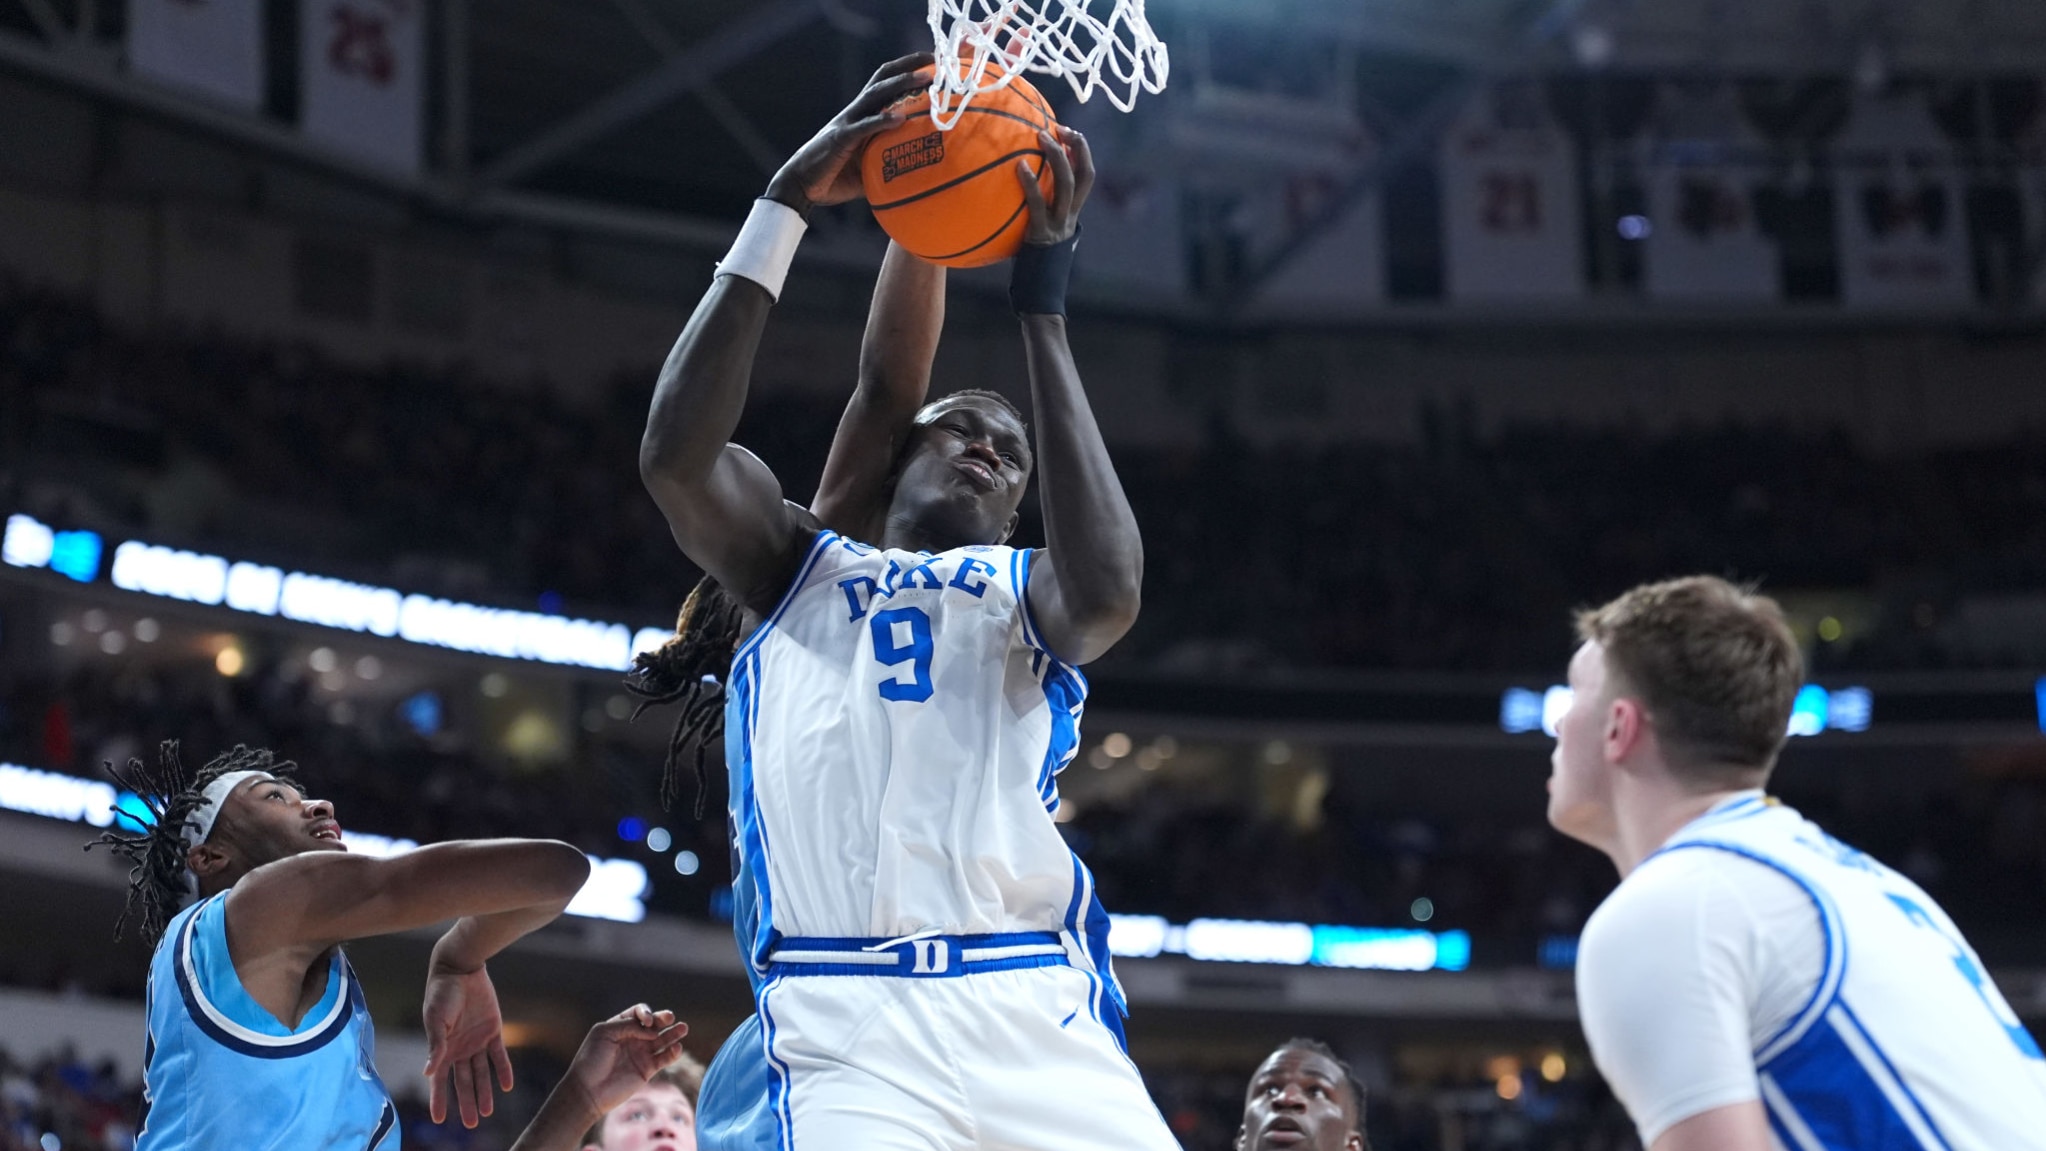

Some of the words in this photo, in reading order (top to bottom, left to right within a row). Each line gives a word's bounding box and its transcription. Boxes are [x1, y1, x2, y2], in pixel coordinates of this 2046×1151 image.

[890, 138, 924, 160] MARCH
[896, 145, 944, 170] MADNESS
[838, 557, 997, 624] DUKE
[870, 606, 934, 703] 9
[911, 940, 948, 974] D
